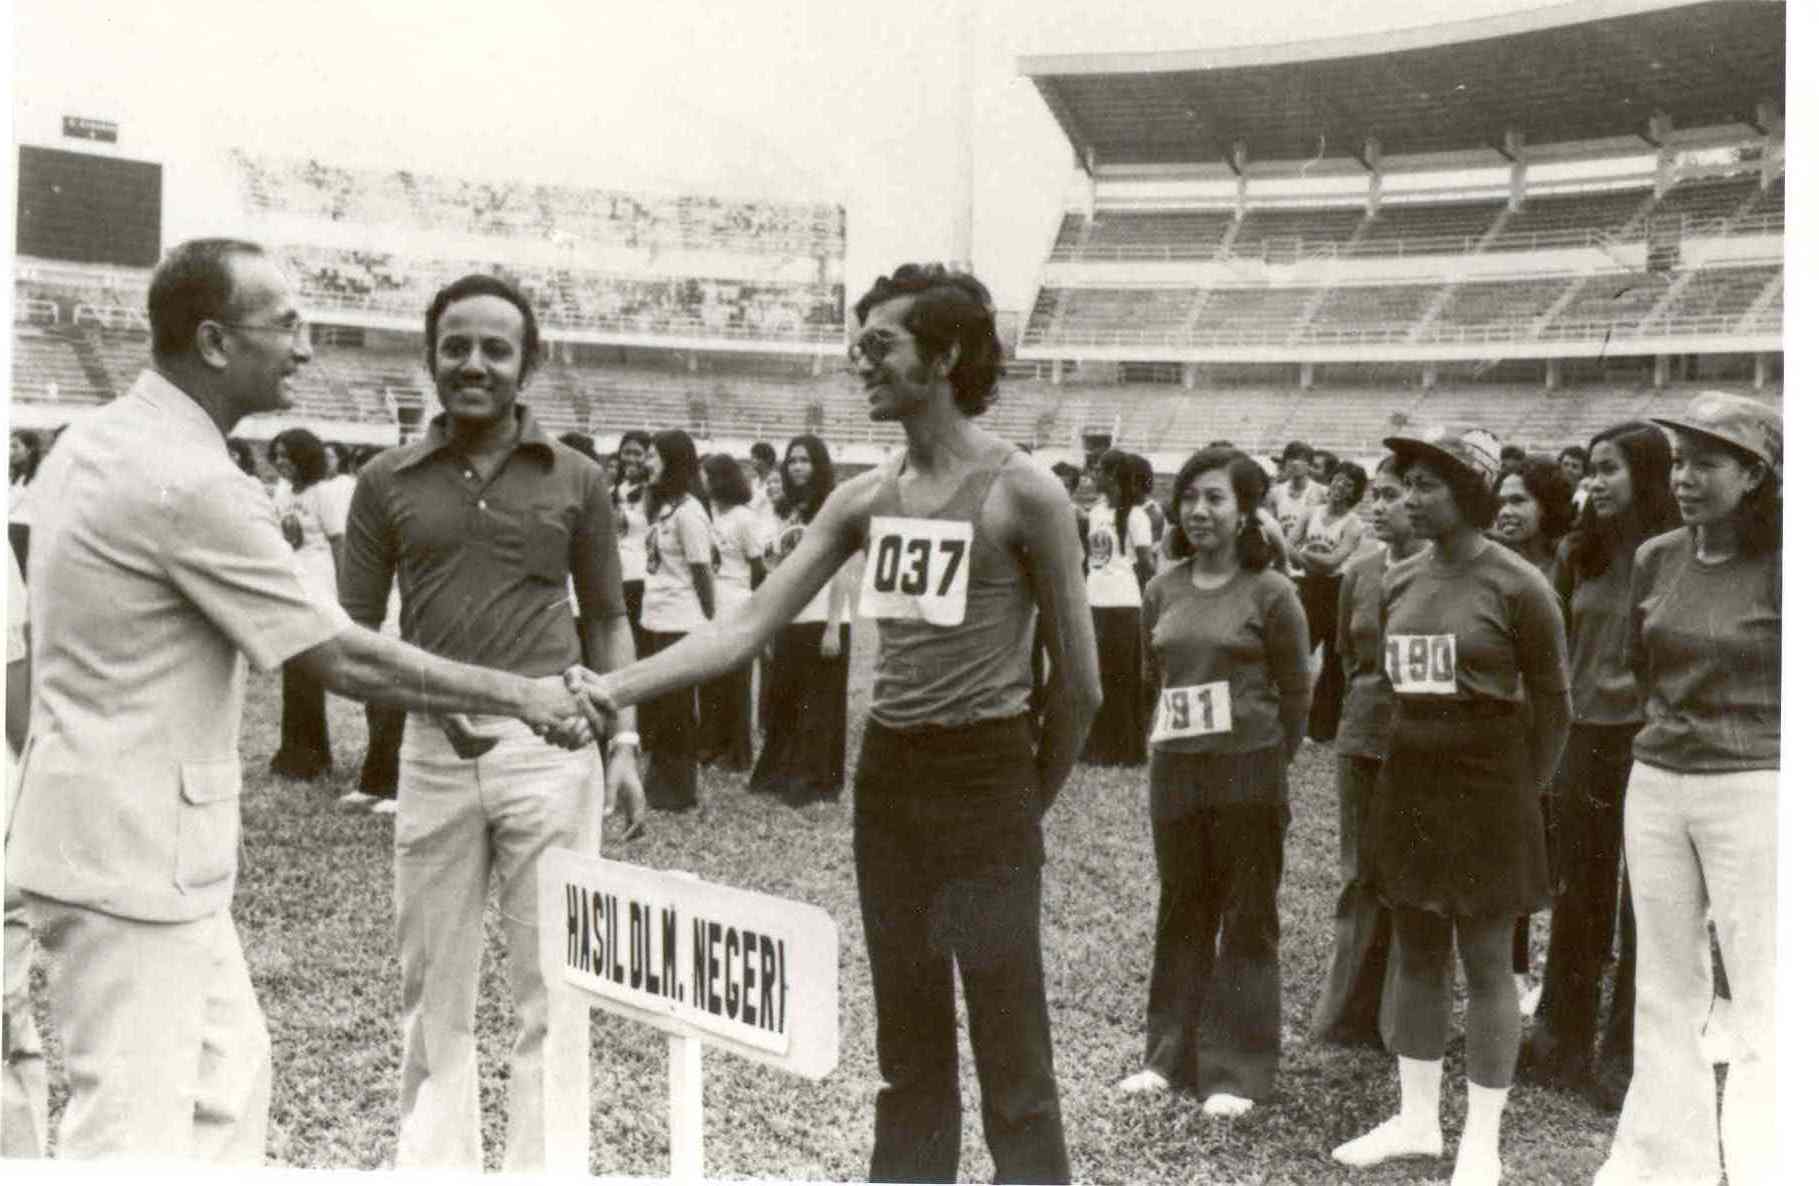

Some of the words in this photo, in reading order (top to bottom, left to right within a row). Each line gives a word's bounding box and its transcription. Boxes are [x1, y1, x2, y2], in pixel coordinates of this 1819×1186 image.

[874, 534, 966, 597] 037
[566, 883, 623, 984] HASIL
[629, 900, 684, 1002] DLM.
[693, 916, 786, 1034] NEGERI
